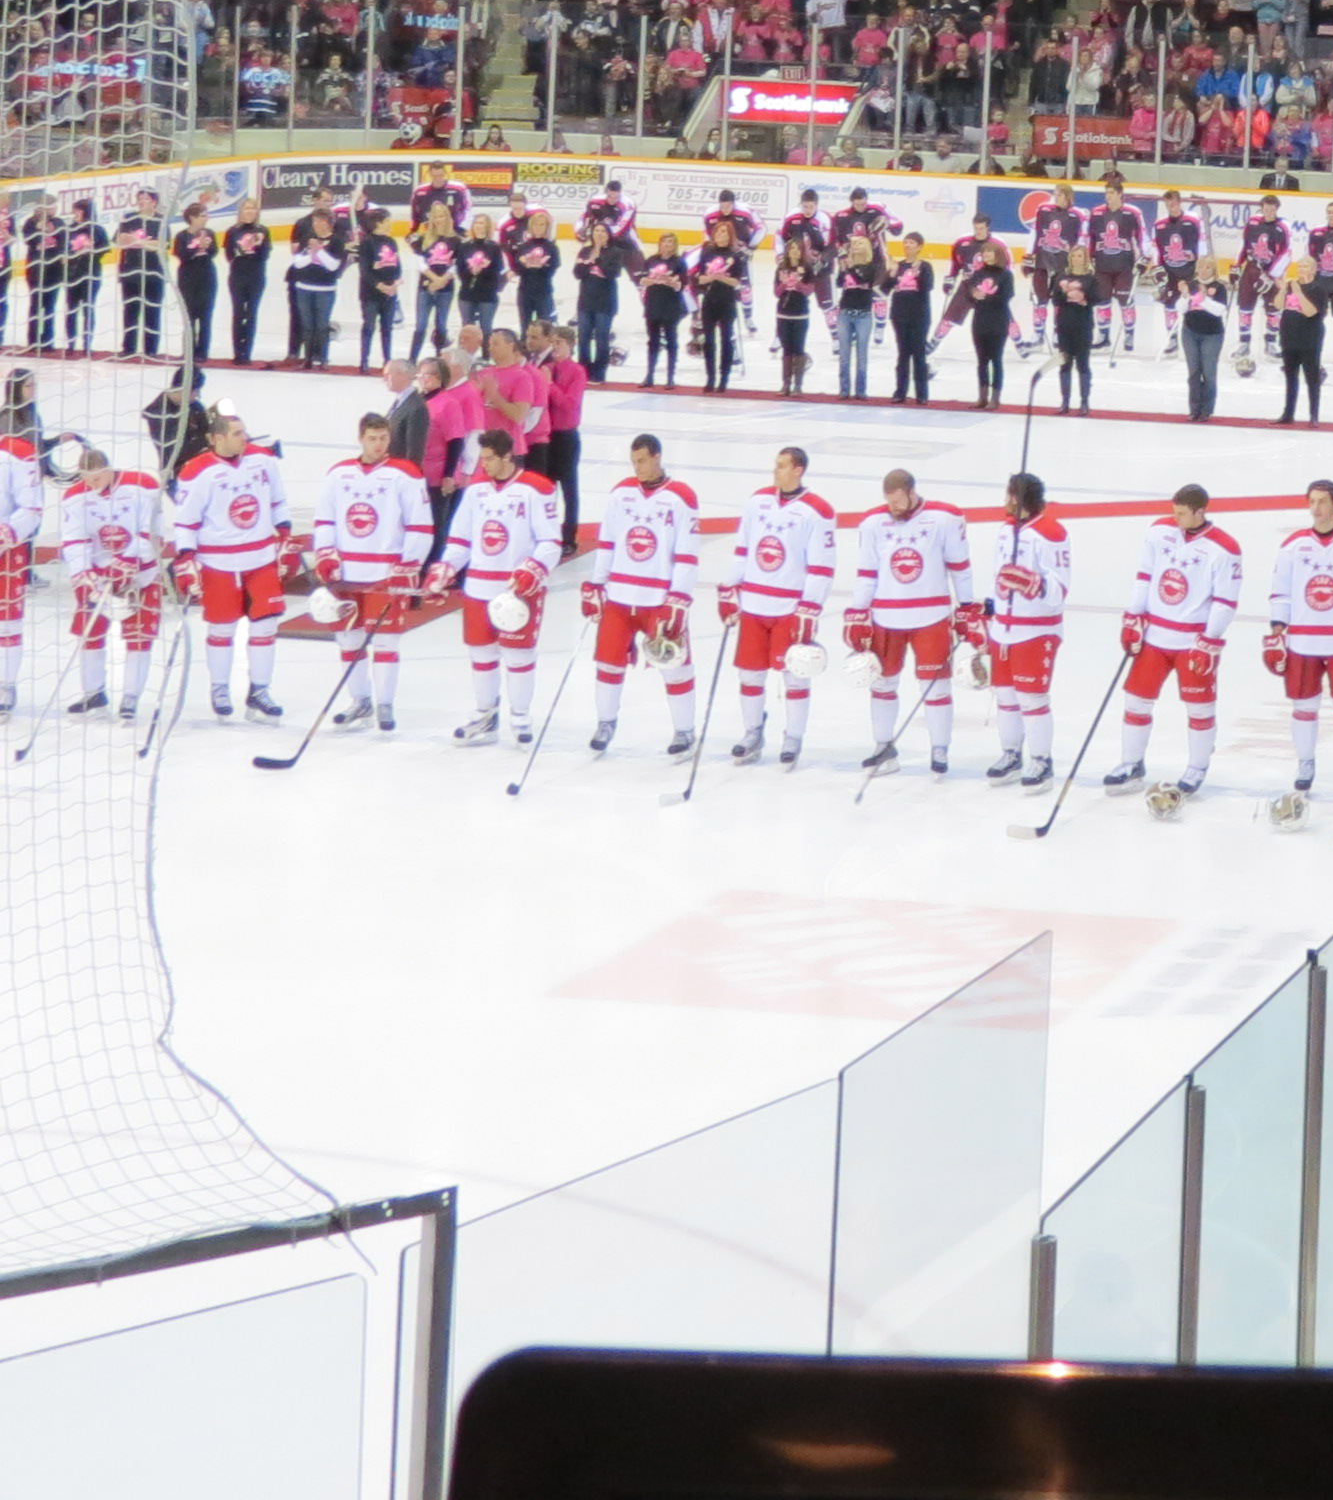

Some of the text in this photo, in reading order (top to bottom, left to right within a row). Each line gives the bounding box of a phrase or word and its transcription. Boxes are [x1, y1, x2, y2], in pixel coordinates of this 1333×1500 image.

[753, 92, 850, 114] Scotiabank
[1061, 131, 1133, 146] Sotiabank
[516, 162, 600, 175] ROOFING
[262, 163, 412, 192] Cleary Homes
[516, 184, 599, 200] 760-0952
